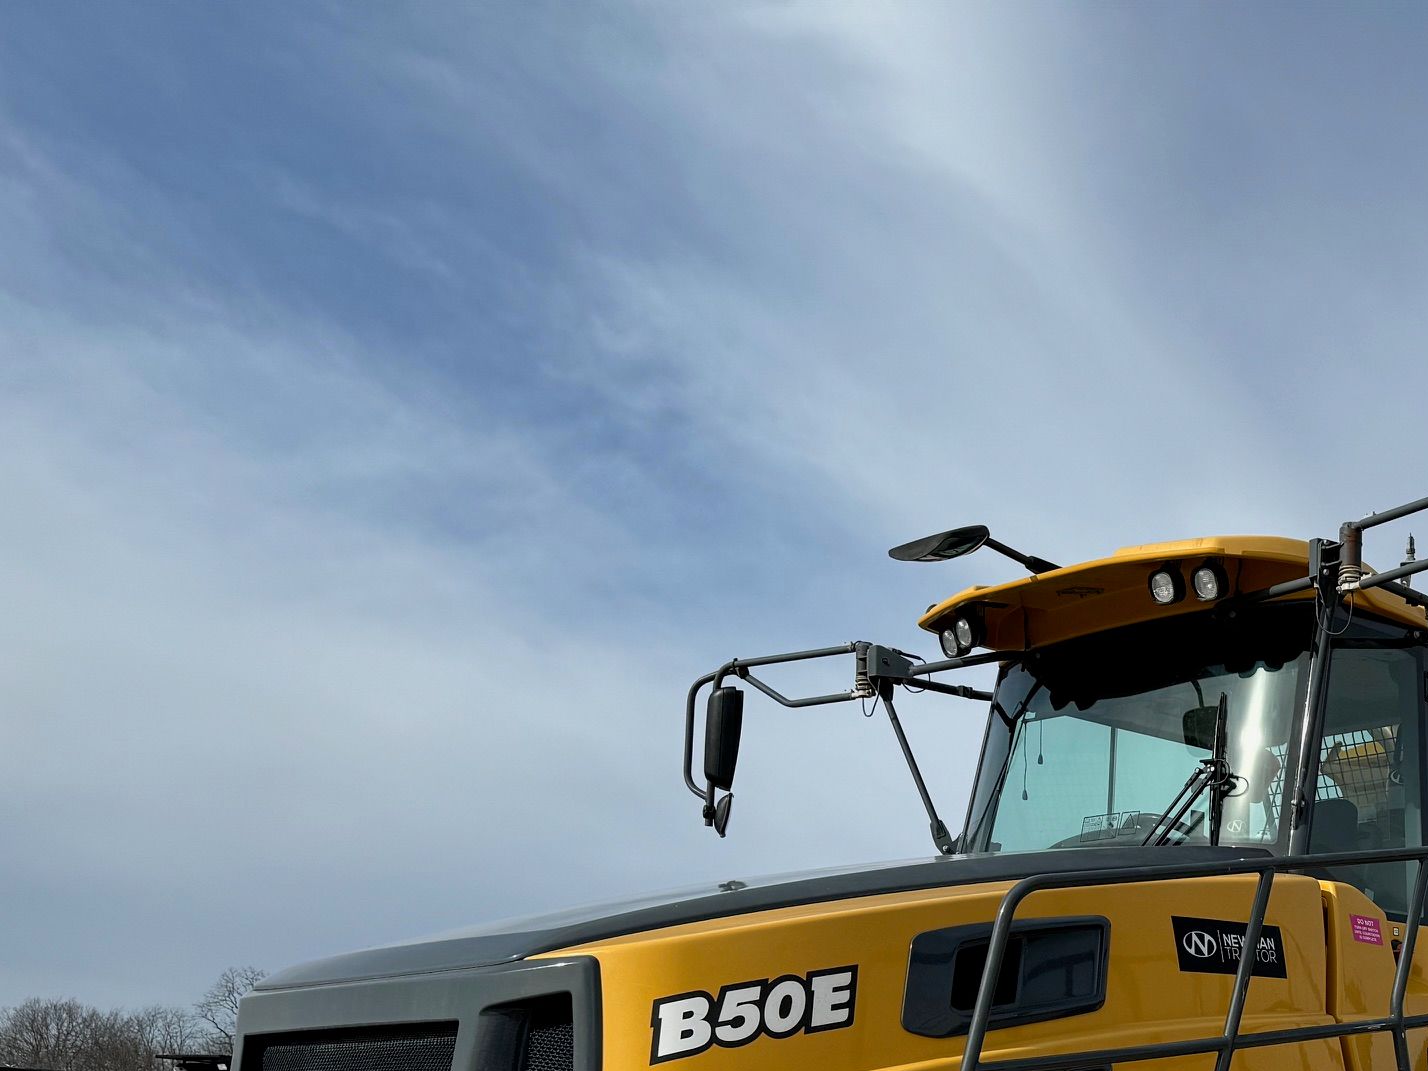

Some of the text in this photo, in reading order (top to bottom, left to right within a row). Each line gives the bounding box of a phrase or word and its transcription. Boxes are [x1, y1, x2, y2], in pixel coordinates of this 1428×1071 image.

[1222, 933, 1276, 950] NEWAN
[1224, 946, 1278, 964] TRTOR
[656, 971, 853, 1058] B50E
